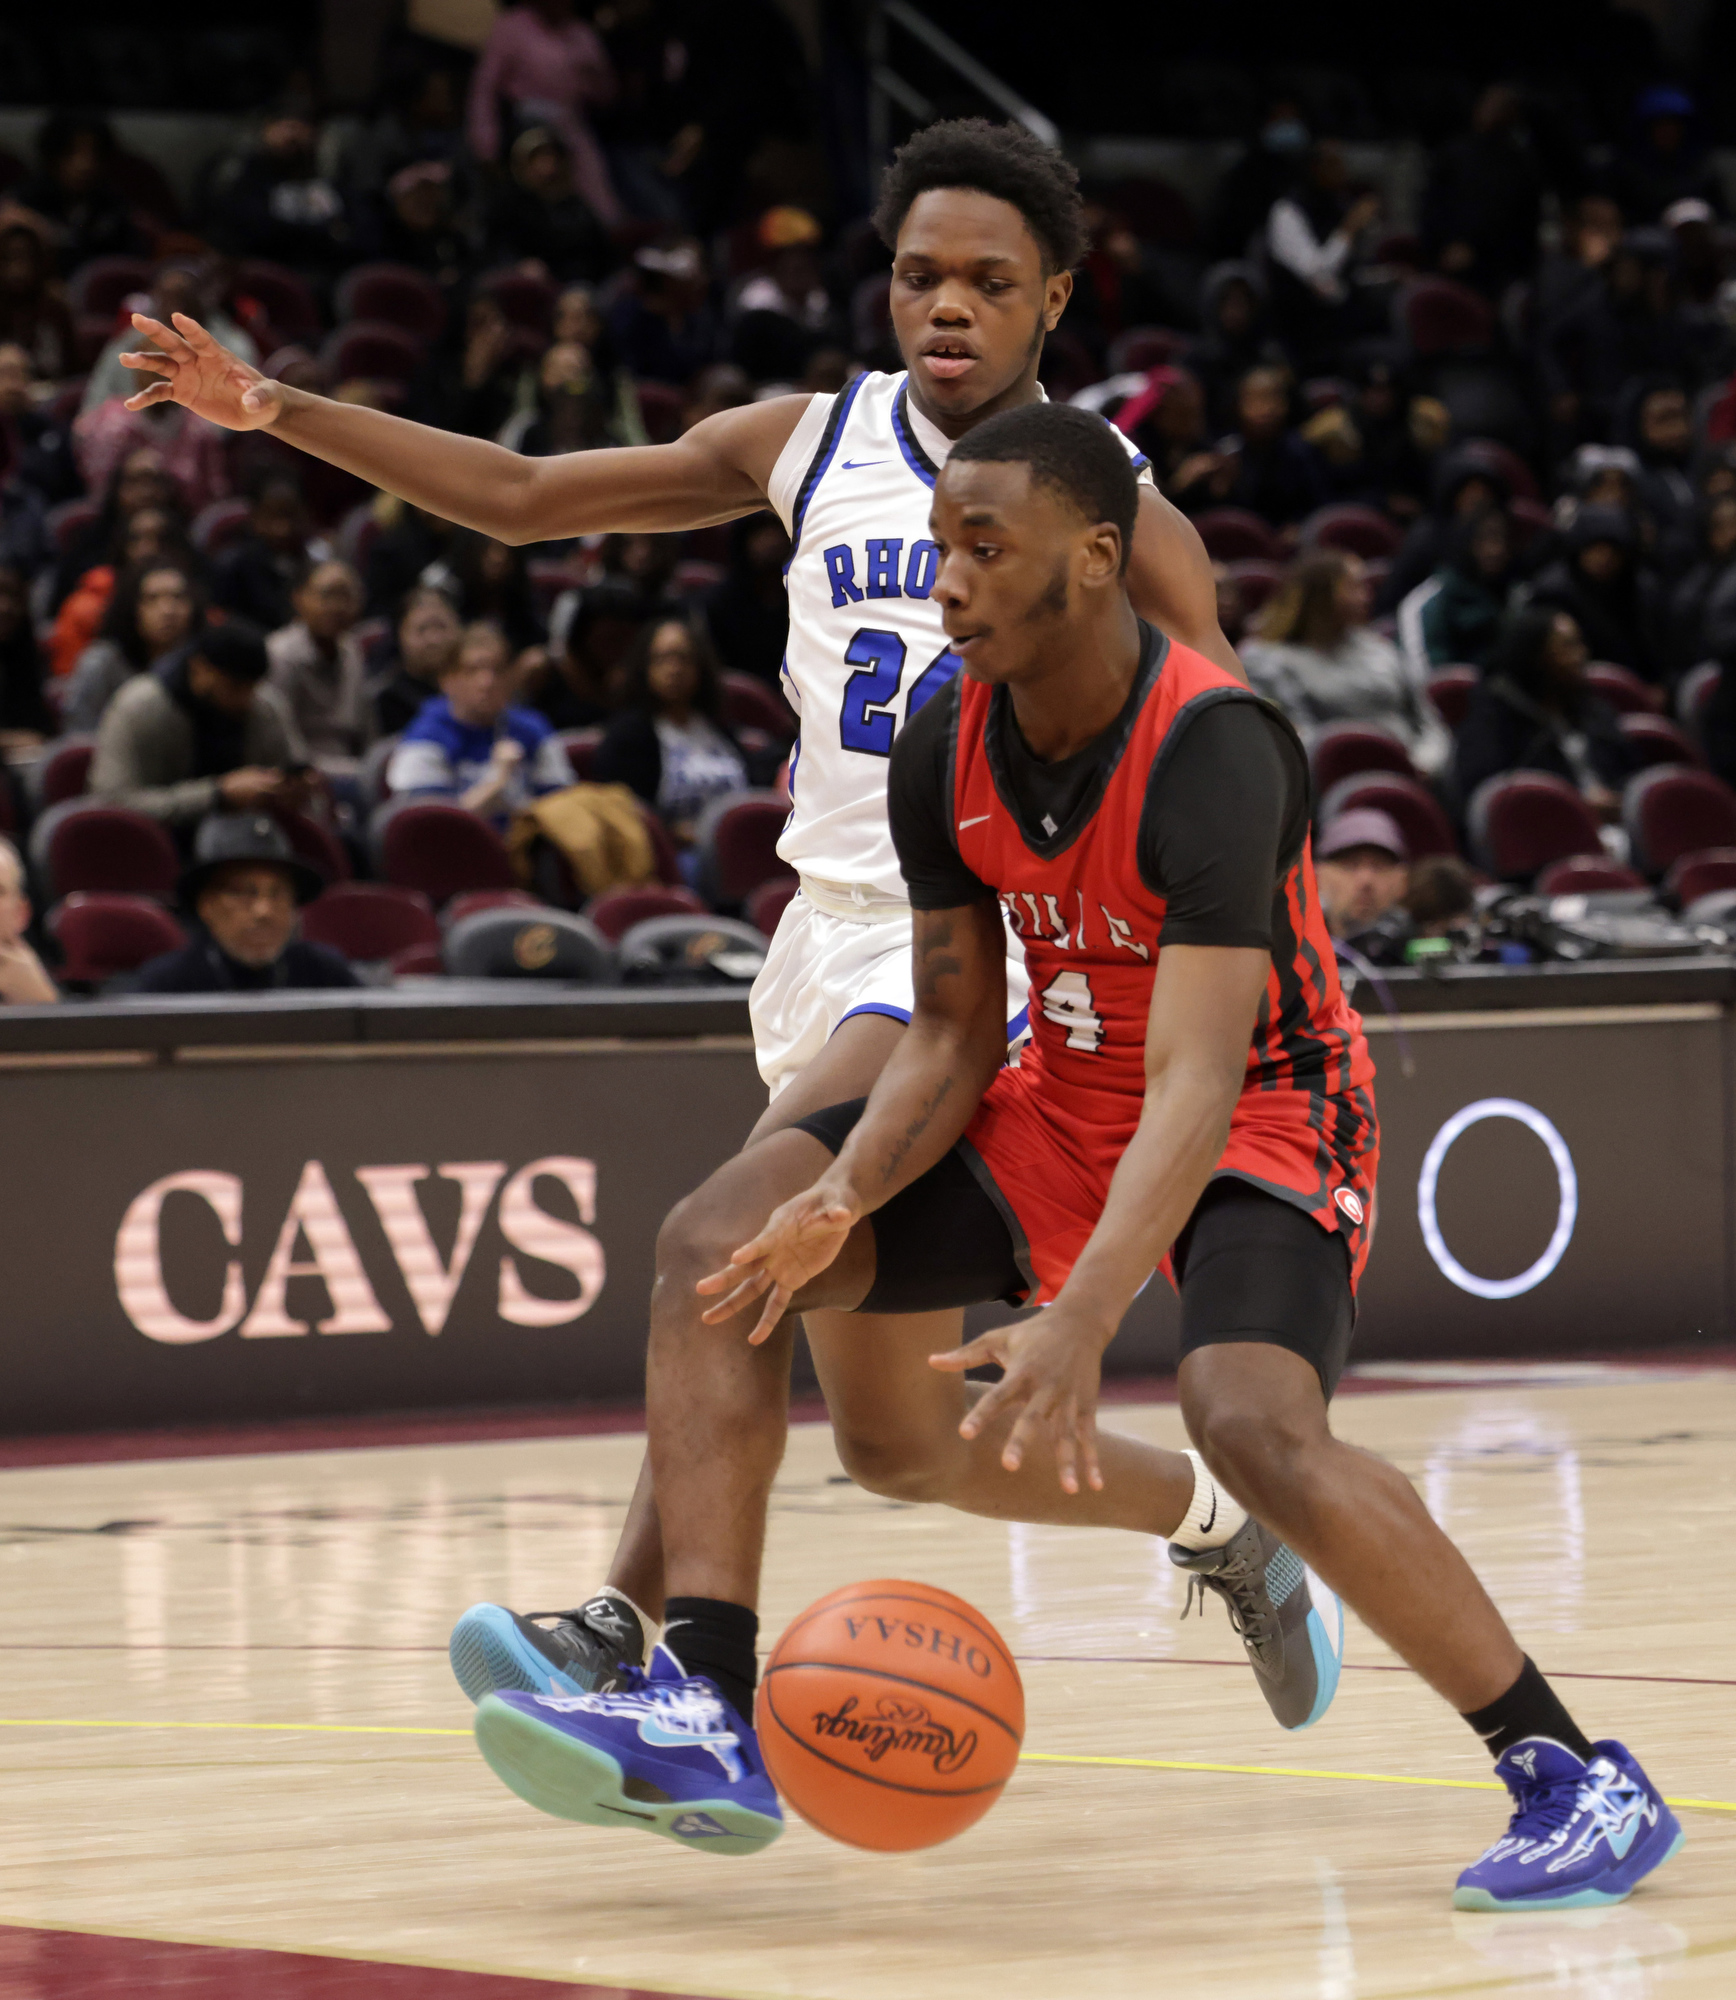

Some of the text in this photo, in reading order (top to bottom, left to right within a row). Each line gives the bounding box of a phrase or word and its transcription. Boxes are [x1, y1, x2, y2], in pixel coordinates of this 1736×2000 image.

[823, 538, 939, 609] RHO
[1041, 968, 1106, 1056] 4
[113, 1154, 607, 1345] CAVS
[844, 1615, 992, 1679] OHSAA
[812, 1695, 978, 1775] Rawlings
